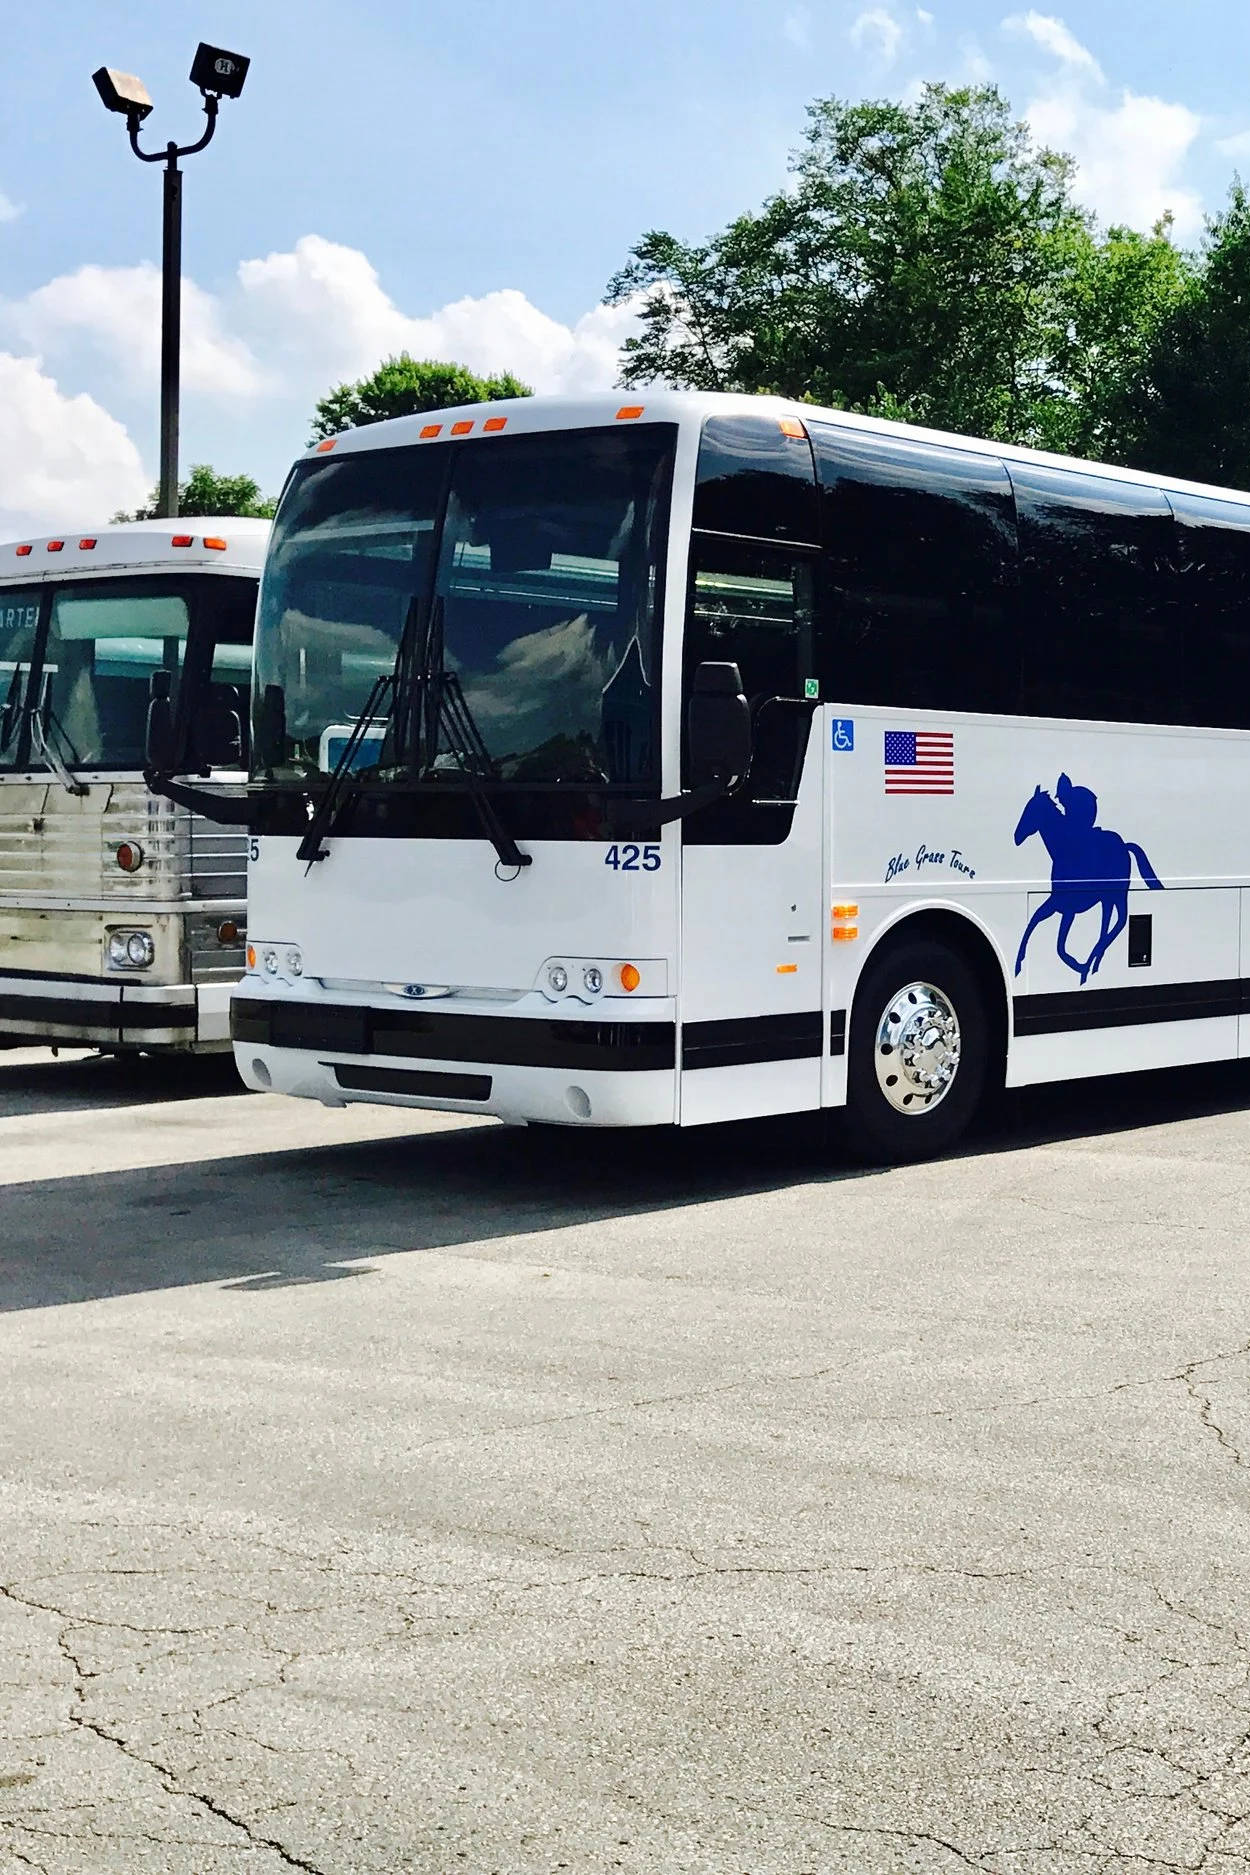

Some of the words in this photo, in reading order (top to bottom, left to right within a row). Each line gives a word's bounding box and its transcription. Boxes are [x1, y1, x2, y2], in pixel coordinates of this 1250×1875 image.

[604, 844, 662, 872] 425
[884, 852, 910, 884] Blue
[915, 844, 946, 871] Grass
[950, 850, 976, 880] Tours
